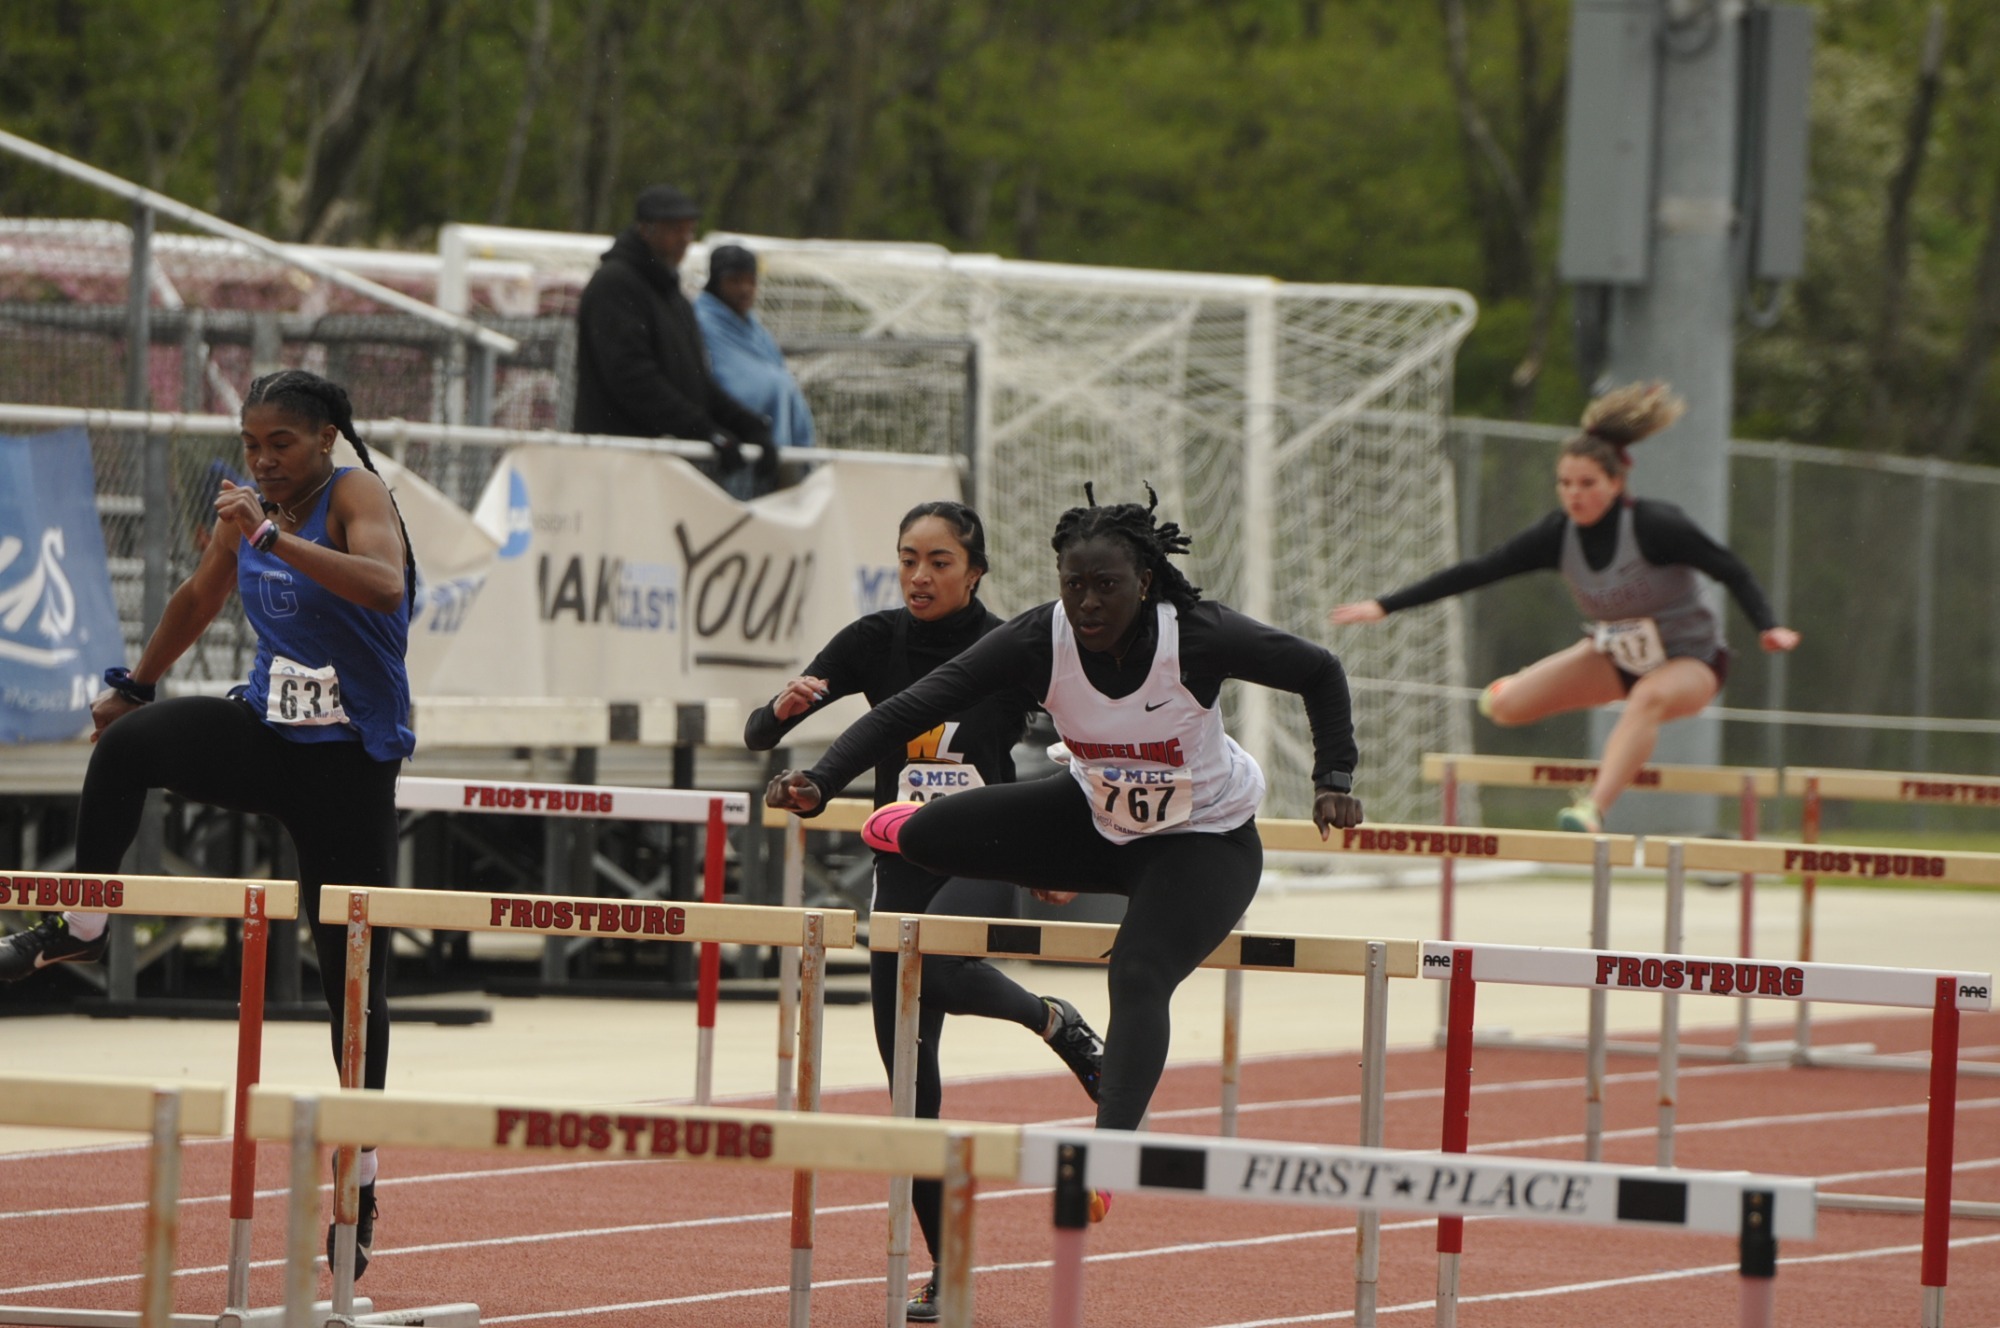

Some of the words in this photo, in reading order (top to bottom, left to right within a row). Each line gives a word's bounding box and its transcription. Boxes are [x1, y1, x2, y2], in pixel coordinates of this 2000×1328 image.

[259, 570, 299, 618] G
[926, 771, 969, 786] MEC
[1124, 768, 1174, 784] MEC
[464, 785, 613, 813] FROSTBURG
[1102, 781, 1176, 823] 767
[1343, 827, 1499, 856] FROSTBURG
[1784, 850, 1946, 877] FROSTBURG
[490, 898, 686, 935] FROSTBURG
[1596, 955, 1804, 996] FROSTBURG
[496, 1108, 773, 1159] FROSTBURG
